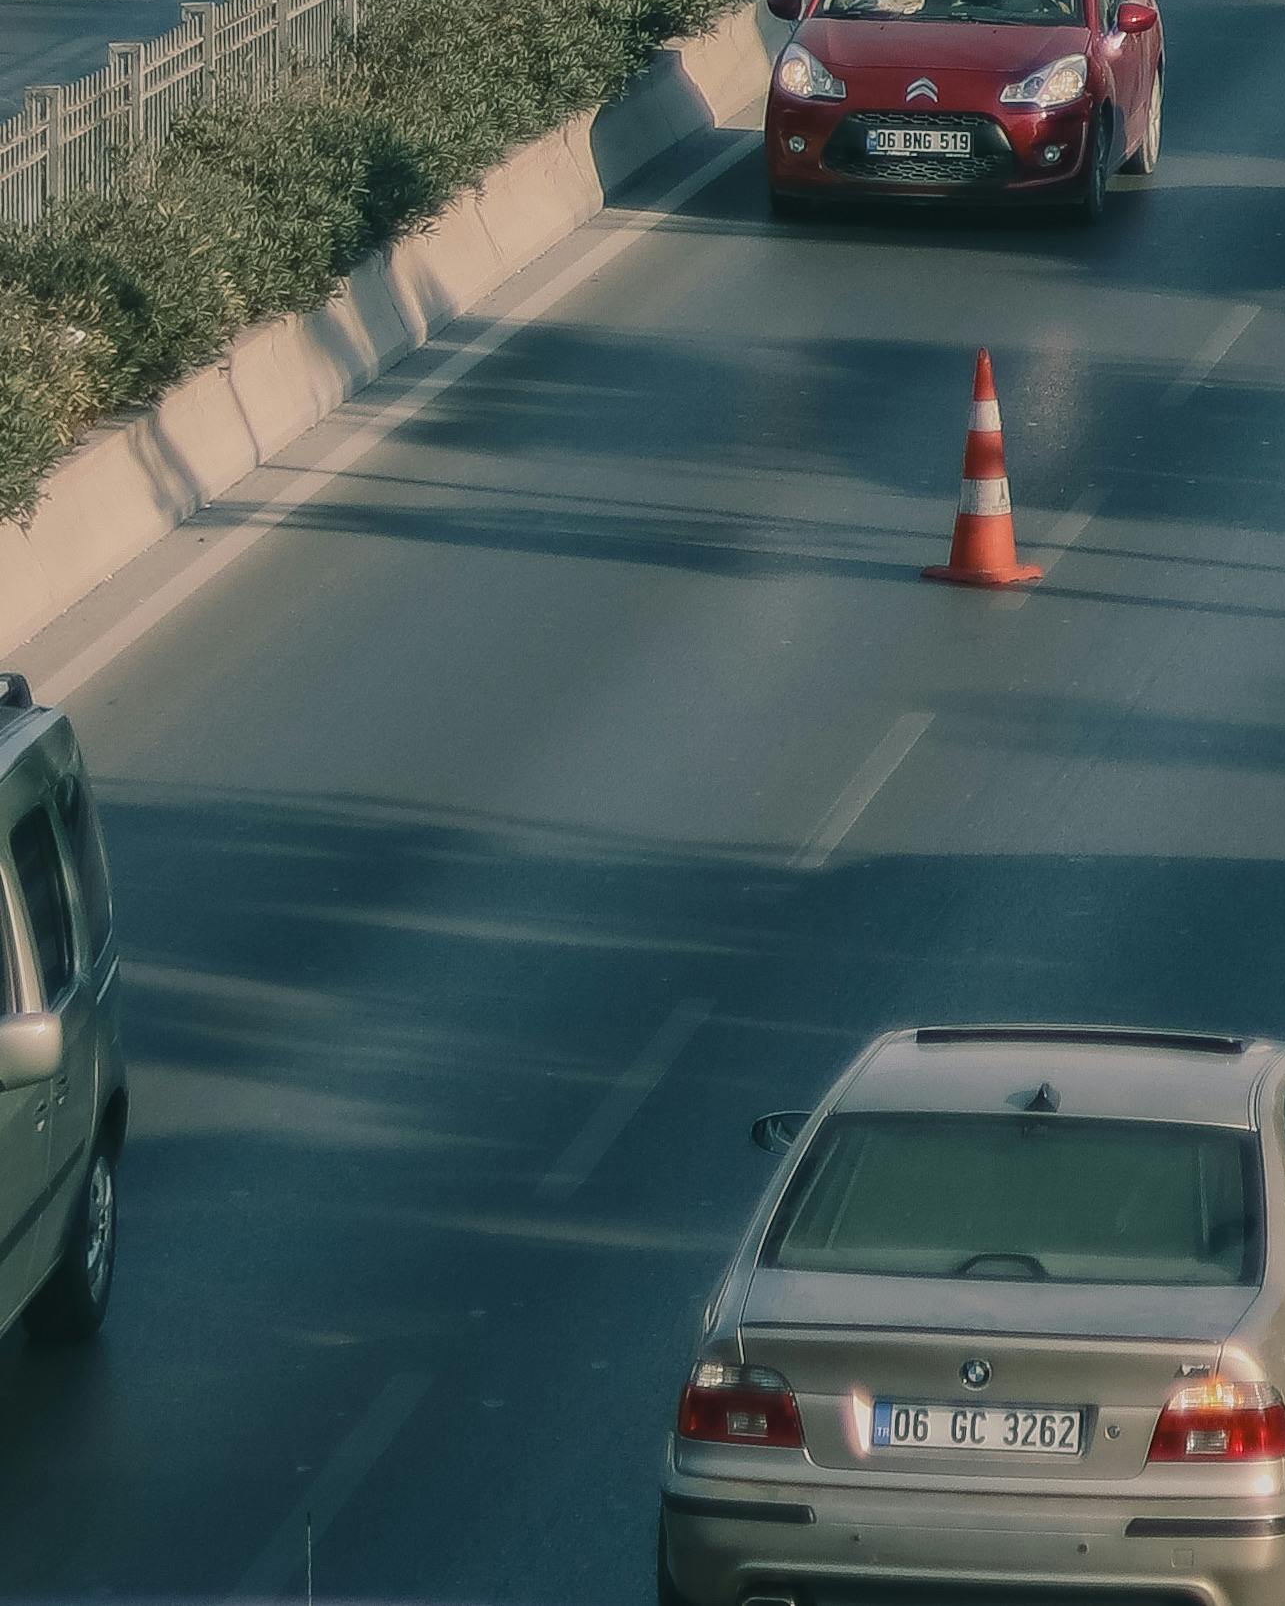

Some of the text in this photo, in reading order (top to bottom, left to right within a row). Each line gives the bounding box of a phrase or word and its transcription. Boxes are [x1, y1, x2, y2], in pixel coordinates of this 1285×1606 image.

[878, 131, 969, 151] 06 BNG 519
[877, 1407, 1077, 1449] TR 06 GC 3262
